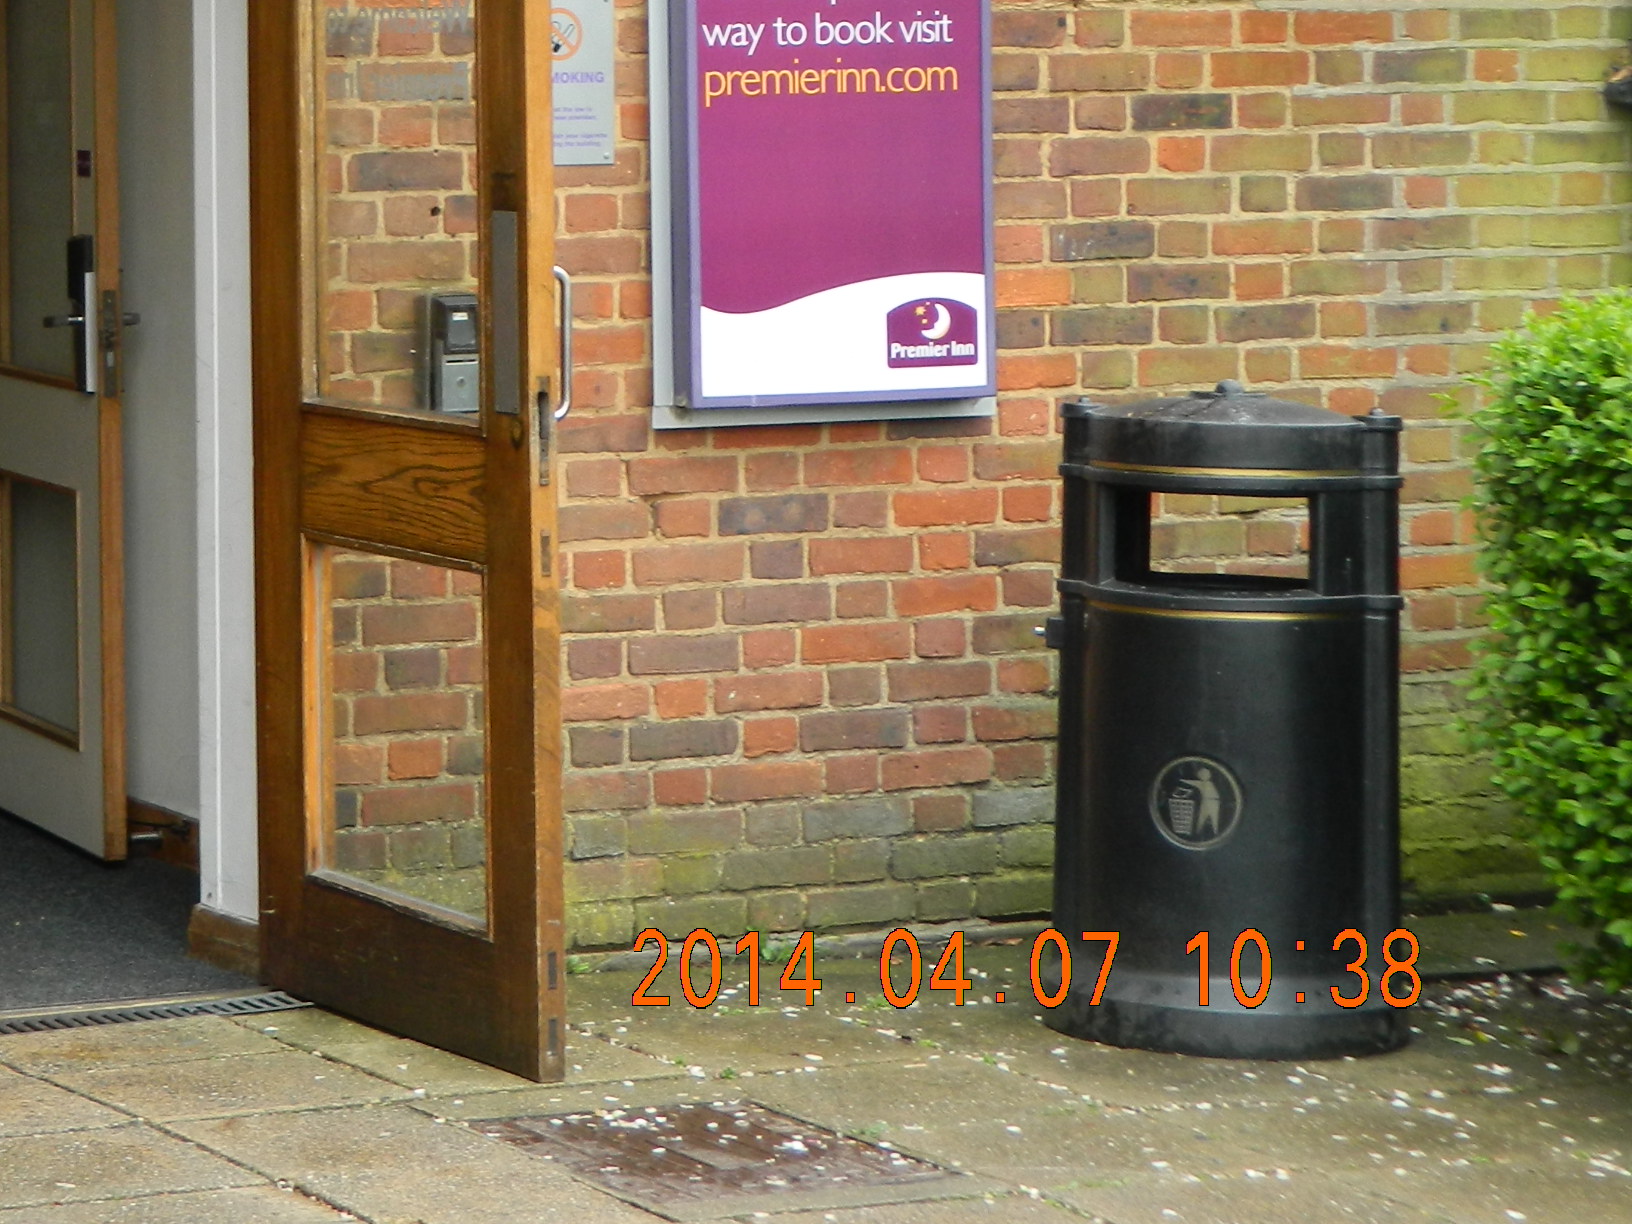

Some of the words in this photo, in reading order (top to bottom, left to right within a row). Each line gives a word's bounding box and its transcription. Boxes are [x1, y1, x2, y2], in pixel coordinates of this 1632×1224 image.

[701, 22, 765, 56] way
[773, 17, 808, 45] to
[815, 11, 894, 45] book
[899, 10, 954, 43] visit
[704, 57, 959, 108] premierinn.com
[890, 341, 950, 359] Premier
[951, 341, 975, 356] Inn
